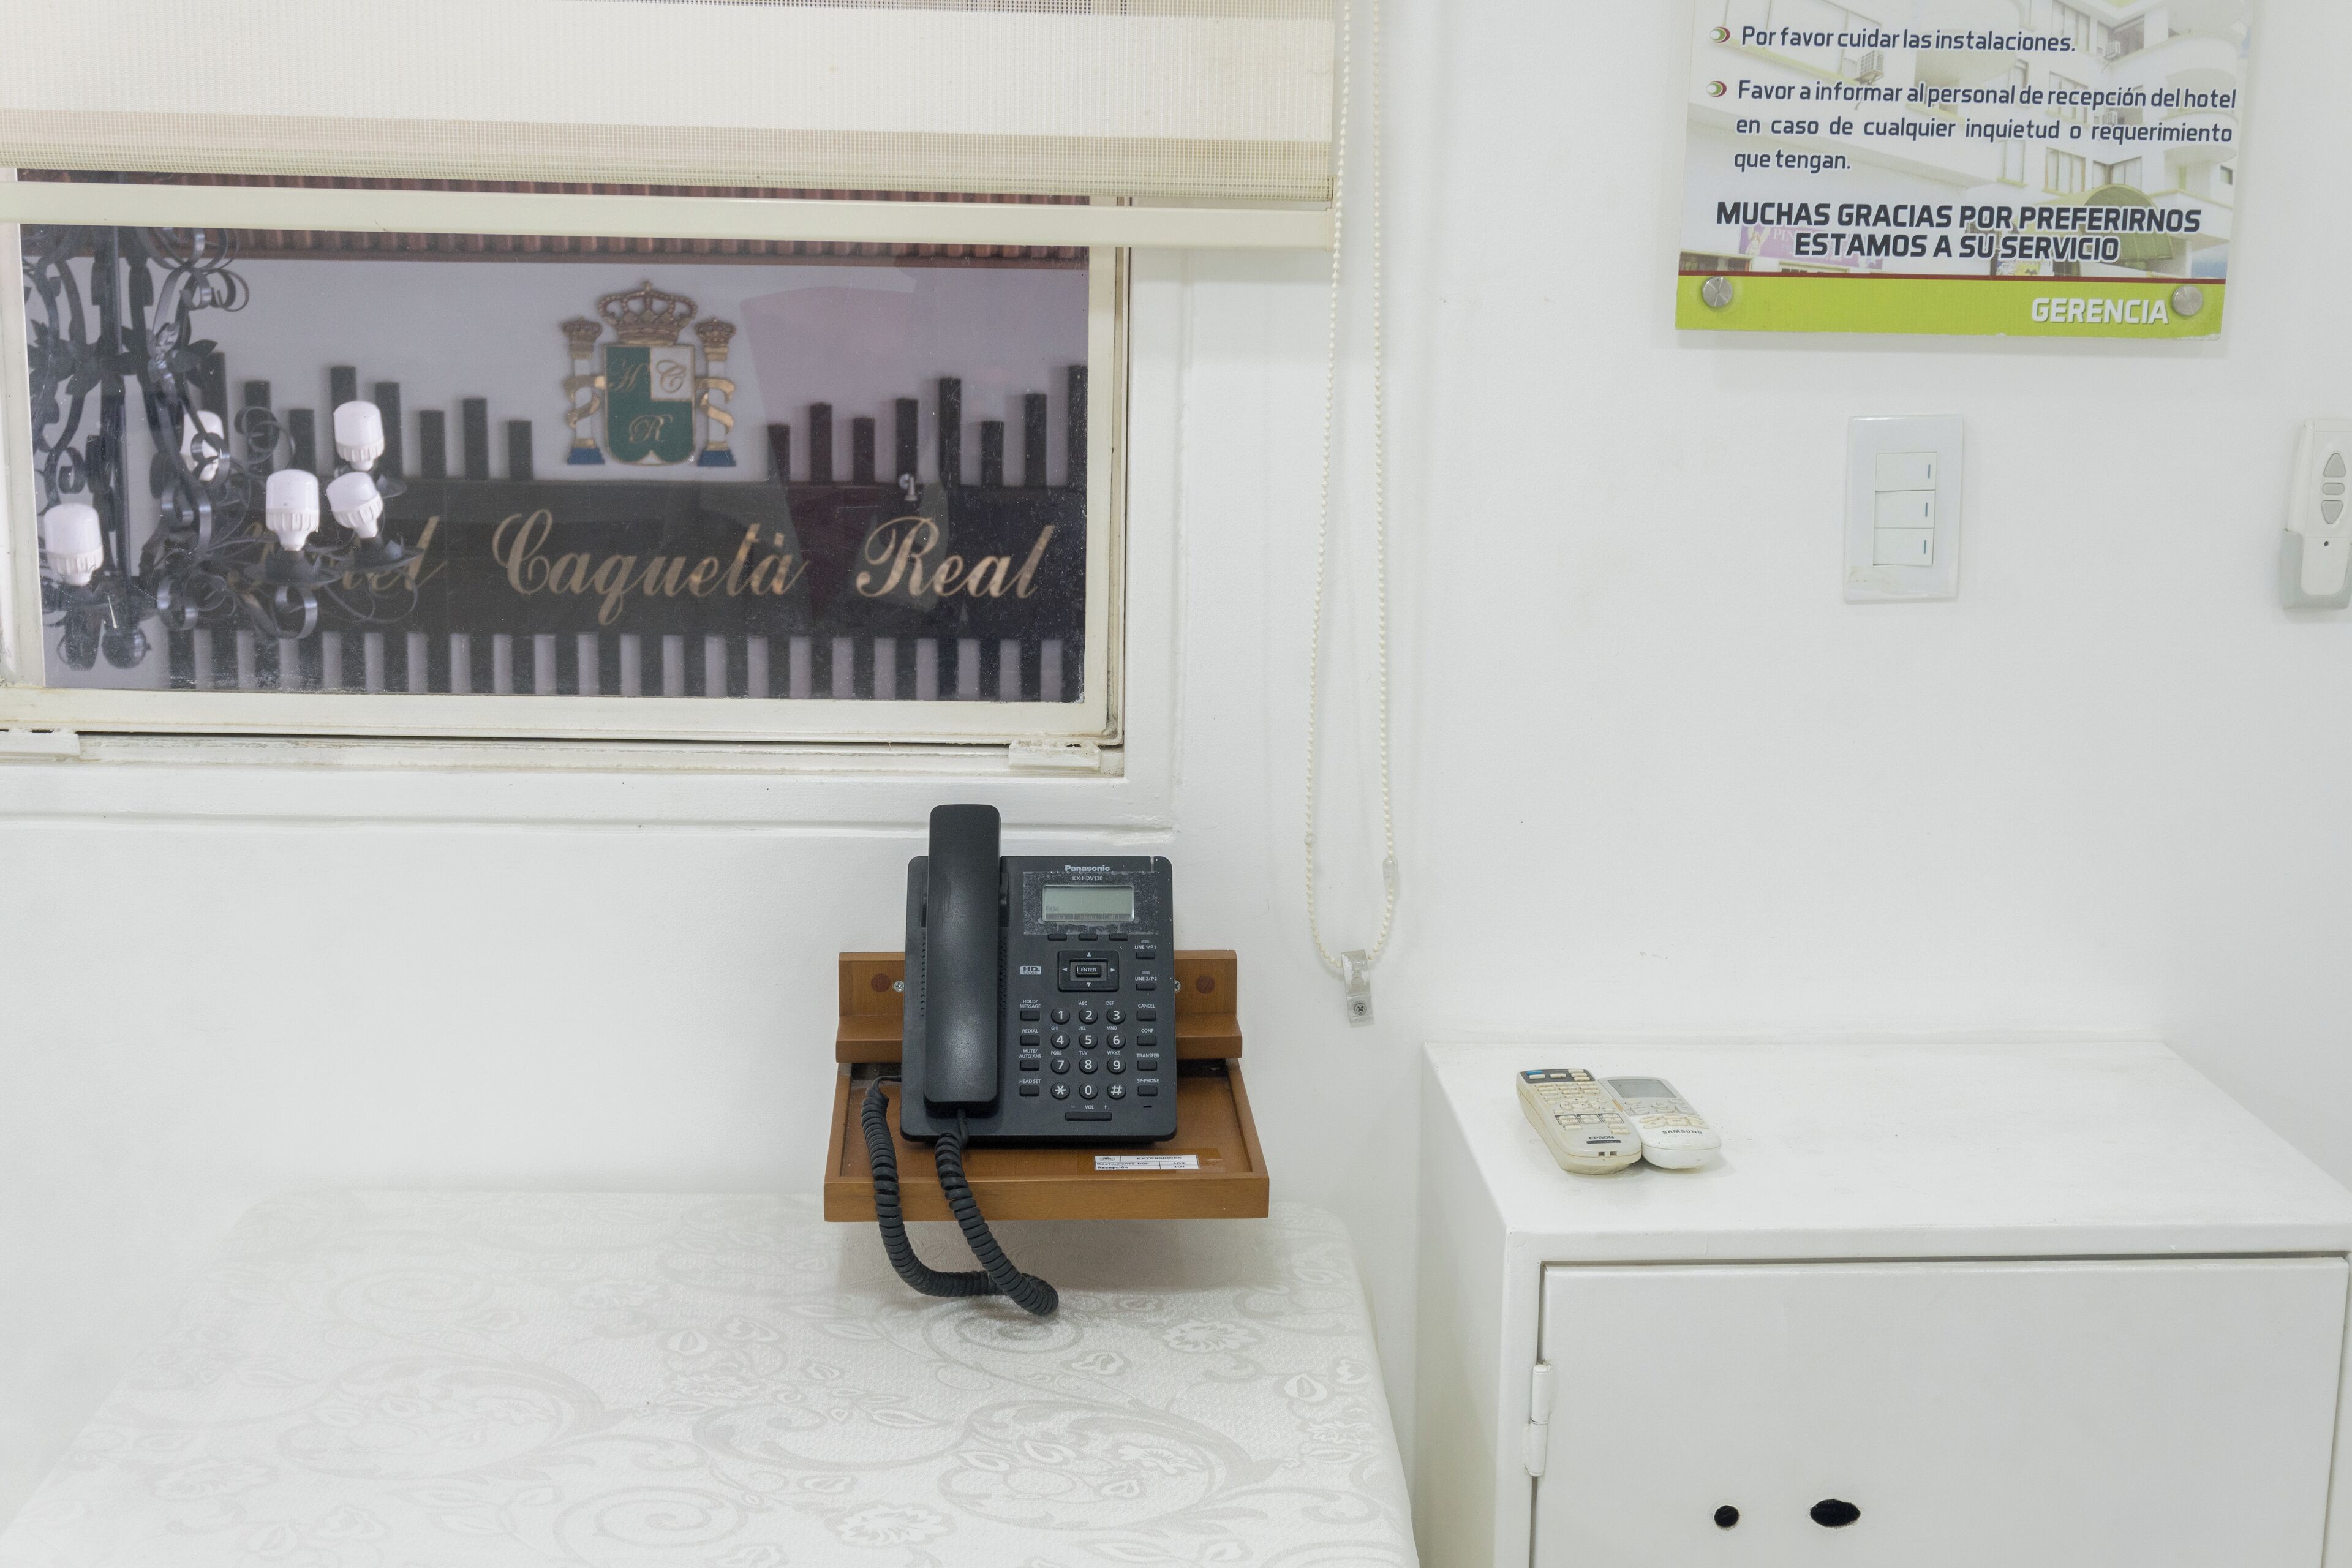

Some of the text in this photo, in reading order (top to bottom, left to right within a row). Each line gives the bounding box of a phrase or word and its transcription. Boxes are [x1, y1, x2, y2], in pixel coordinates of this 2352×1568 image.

[1742, 26, 2075, 51] Por favor cuidar las instalaciones.
[1738, 80, 2236, 110] Favor a informar al personal de recepción del hotel
[1736, 116, 2232, 145] en caso de cualquier inquietud o requerimiento
[1735, 149, 1851, 173] que tengan.
[1716, 202, 2201, 232] MUCHAS GRACIAS POR PREFERIRNOS
[1795, 233, 1927, 257] ESTAMOS
[1933, 235, 1952, 257] A
[1959, 235, 1994, 258] SU
[2001, 236, 2119, 260] SERVICIO
[2032, 298, 2168, 324] GERENCIA
[856, 516, 1055, 599] Real
[1058, 1011, 1063, 1019] 1
[1085, 1011, 1093, 1020] 2
[1113, 1011, 1120, 1020] 3
[1056, 1036, 1064, 1044] 4
[1085, 1035, 1091, 1044] 5
[1113, 1035, 1120, 1045] 6
[1057, 1060, 1065, 1069] 7
[1085, 1060, 1091, 1069] 8
[1114, 1060, 1120, 1069] 9
[1085, 1085, 1092, 1095] 0
[1110, 1085, 1122, 1095] #
